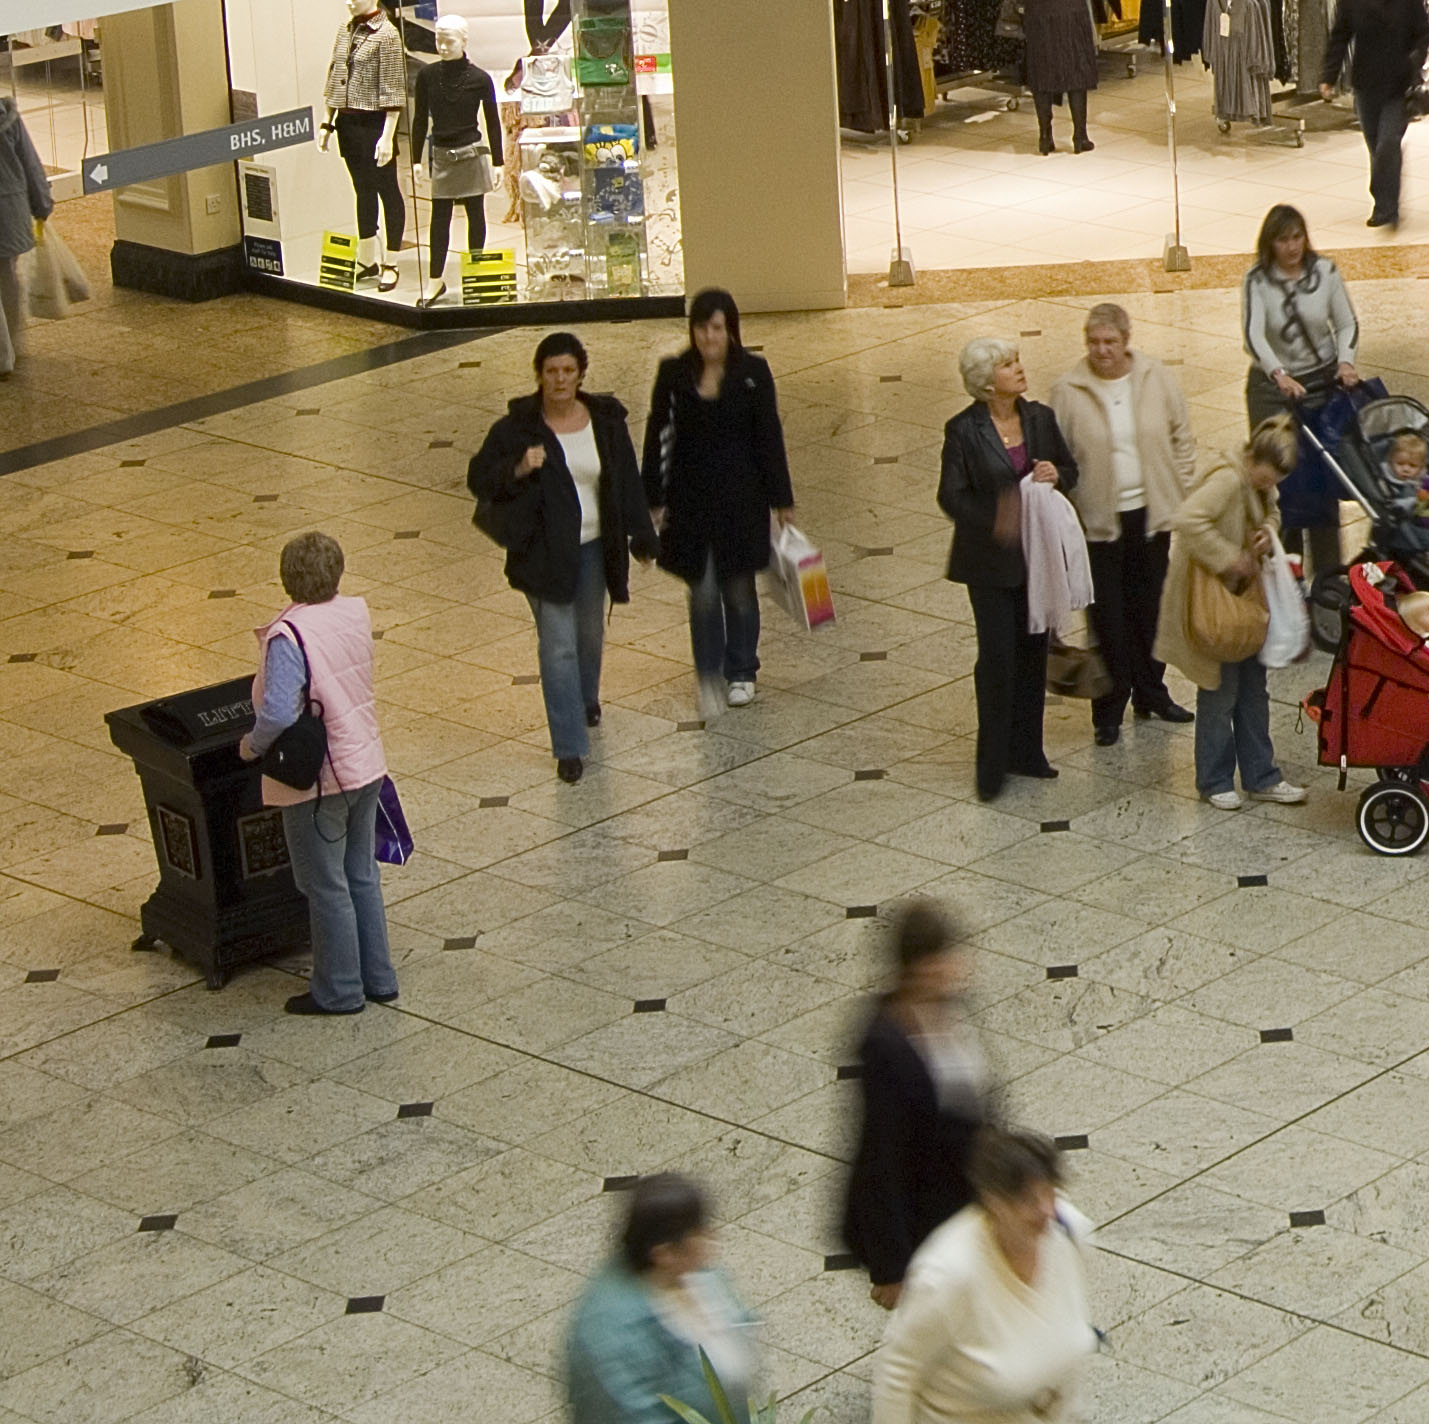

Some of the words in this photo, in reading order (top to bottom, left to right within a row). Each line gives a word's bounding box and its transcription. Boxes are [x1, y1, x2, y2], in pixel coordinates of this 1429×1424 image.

[230, 129, 267, 151] BHS,
[271, 117, 311, 141] H&M
[197, 699, 255, 727] LITT
